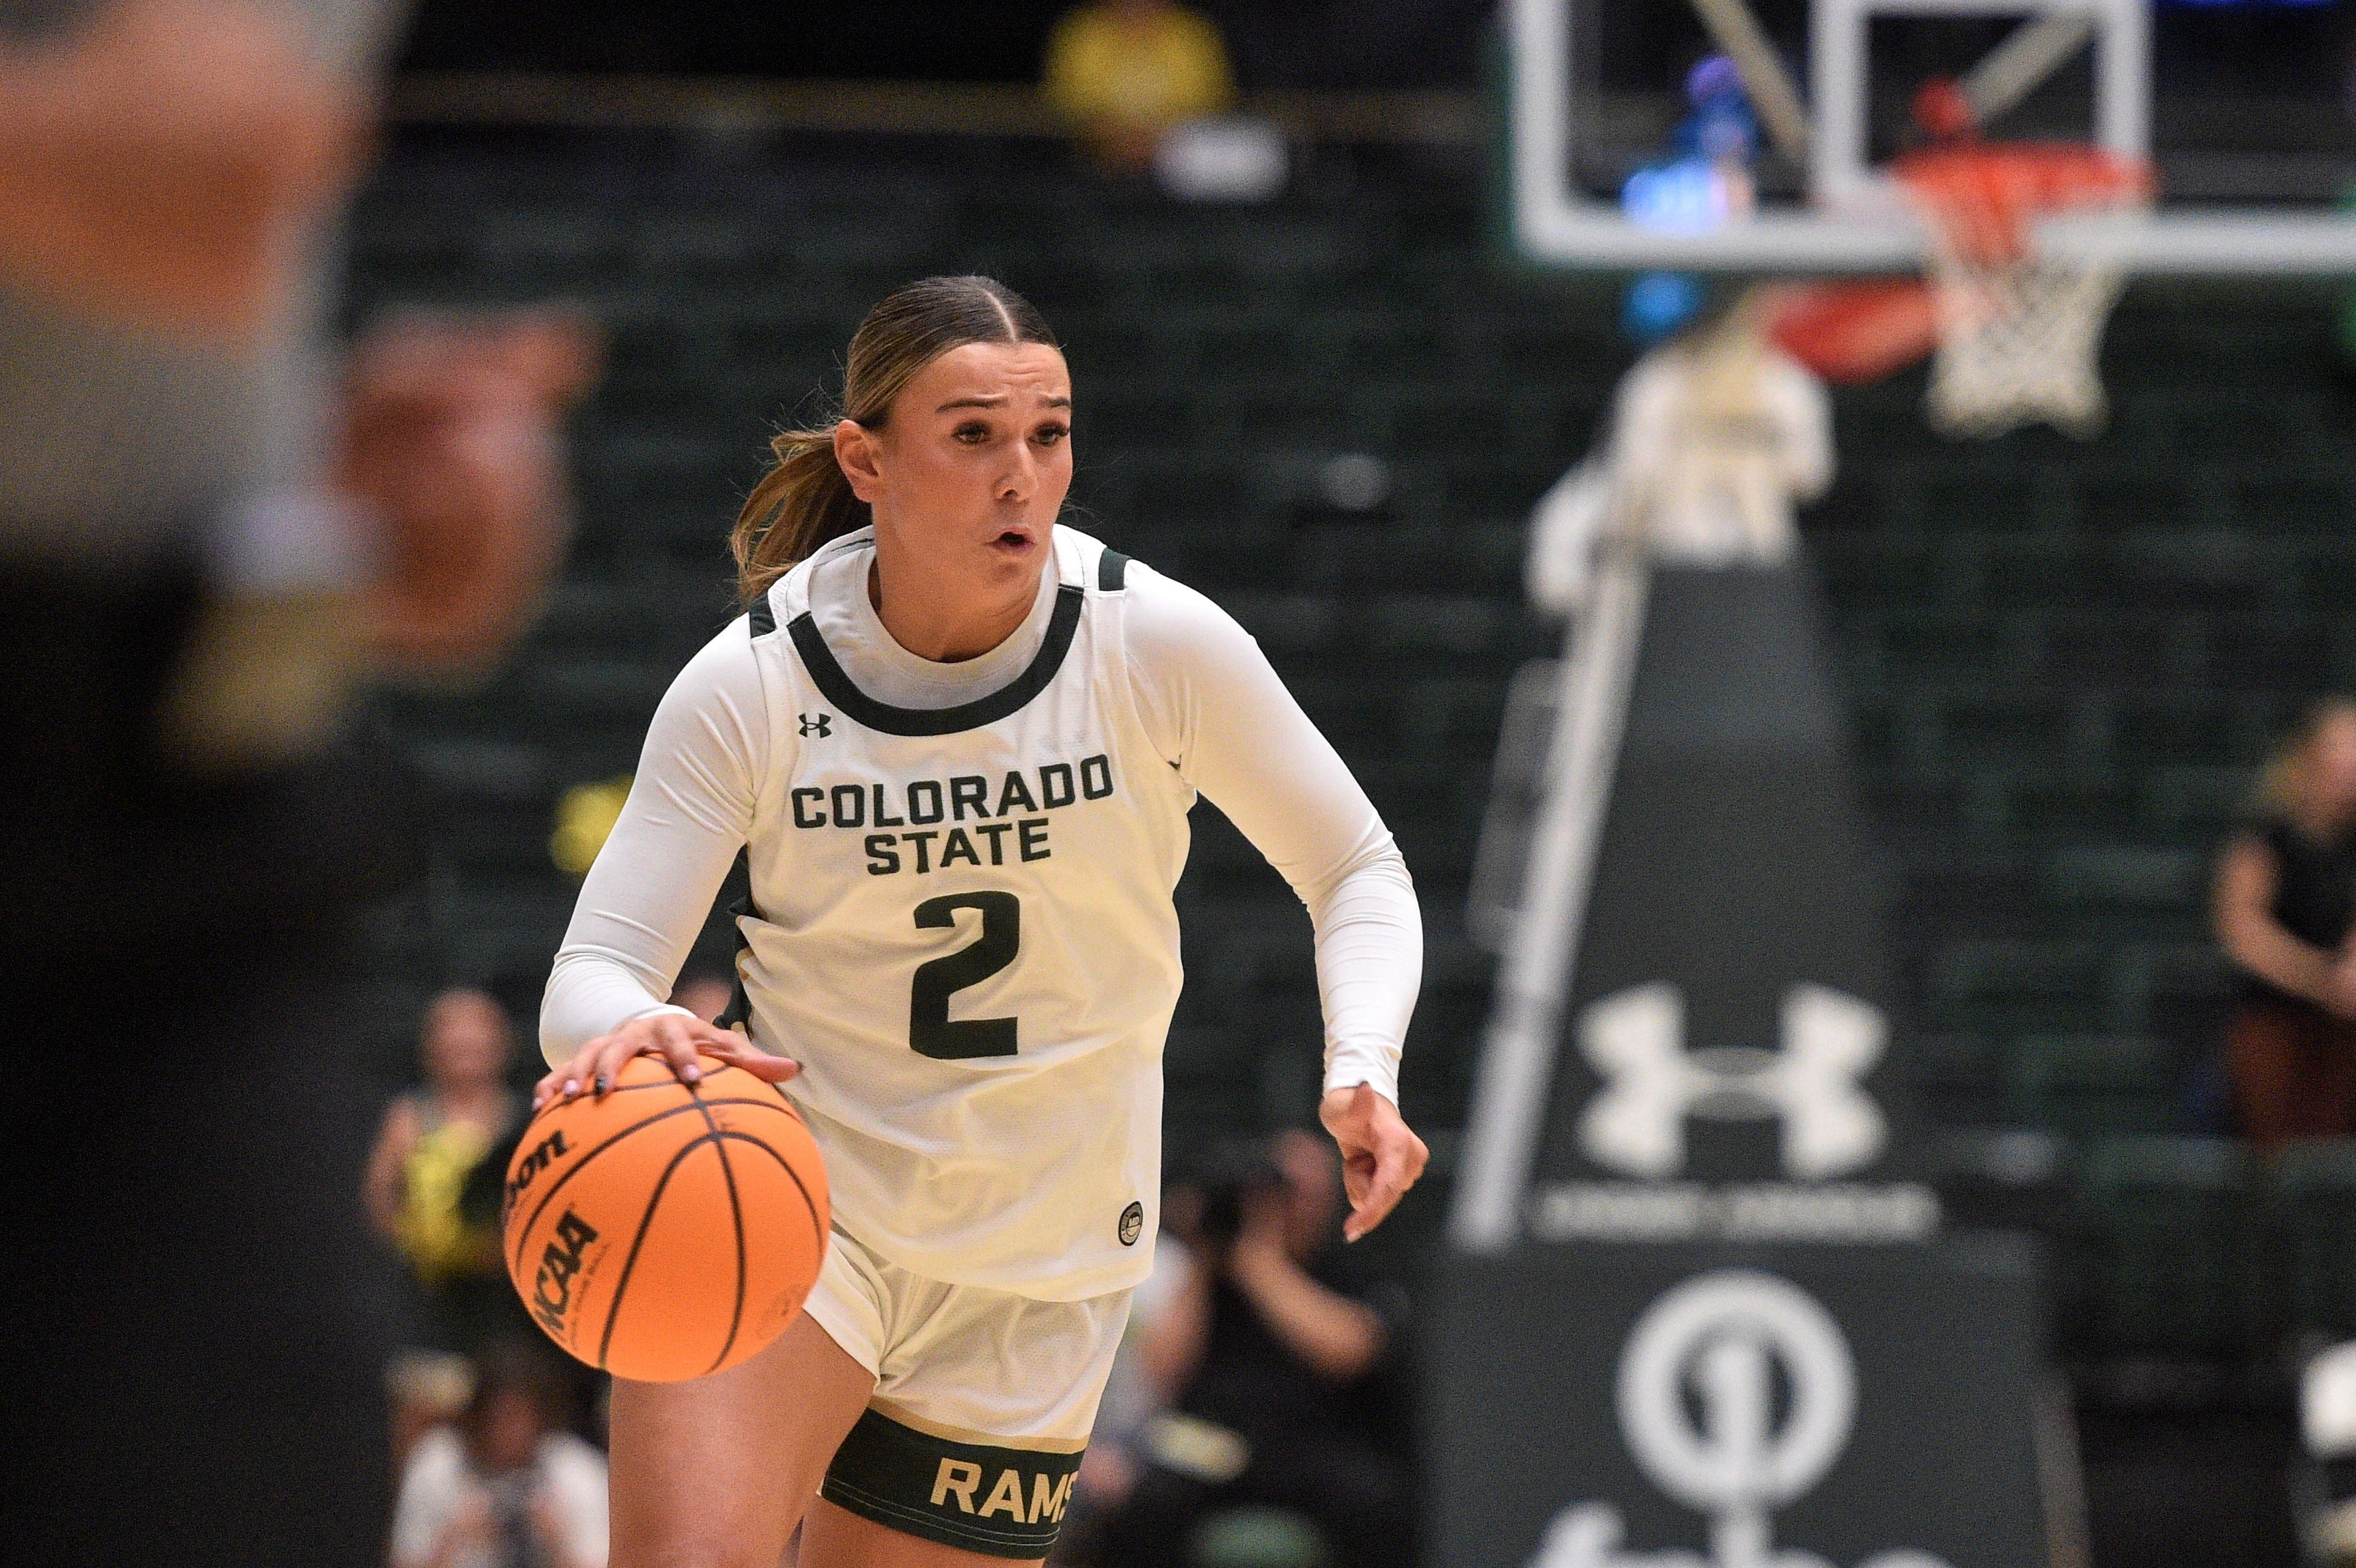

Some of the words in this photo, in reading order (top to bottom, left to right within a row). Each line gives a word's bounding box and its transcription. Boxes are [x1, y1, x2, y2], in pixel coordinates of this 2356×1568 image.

[791, 754, 1113, 829] COLORADO
[865, 818, 1051, 875] STATE
[909, 890, 1020, 1060] 2
[533, 1209, 598, 1342] NCAA
